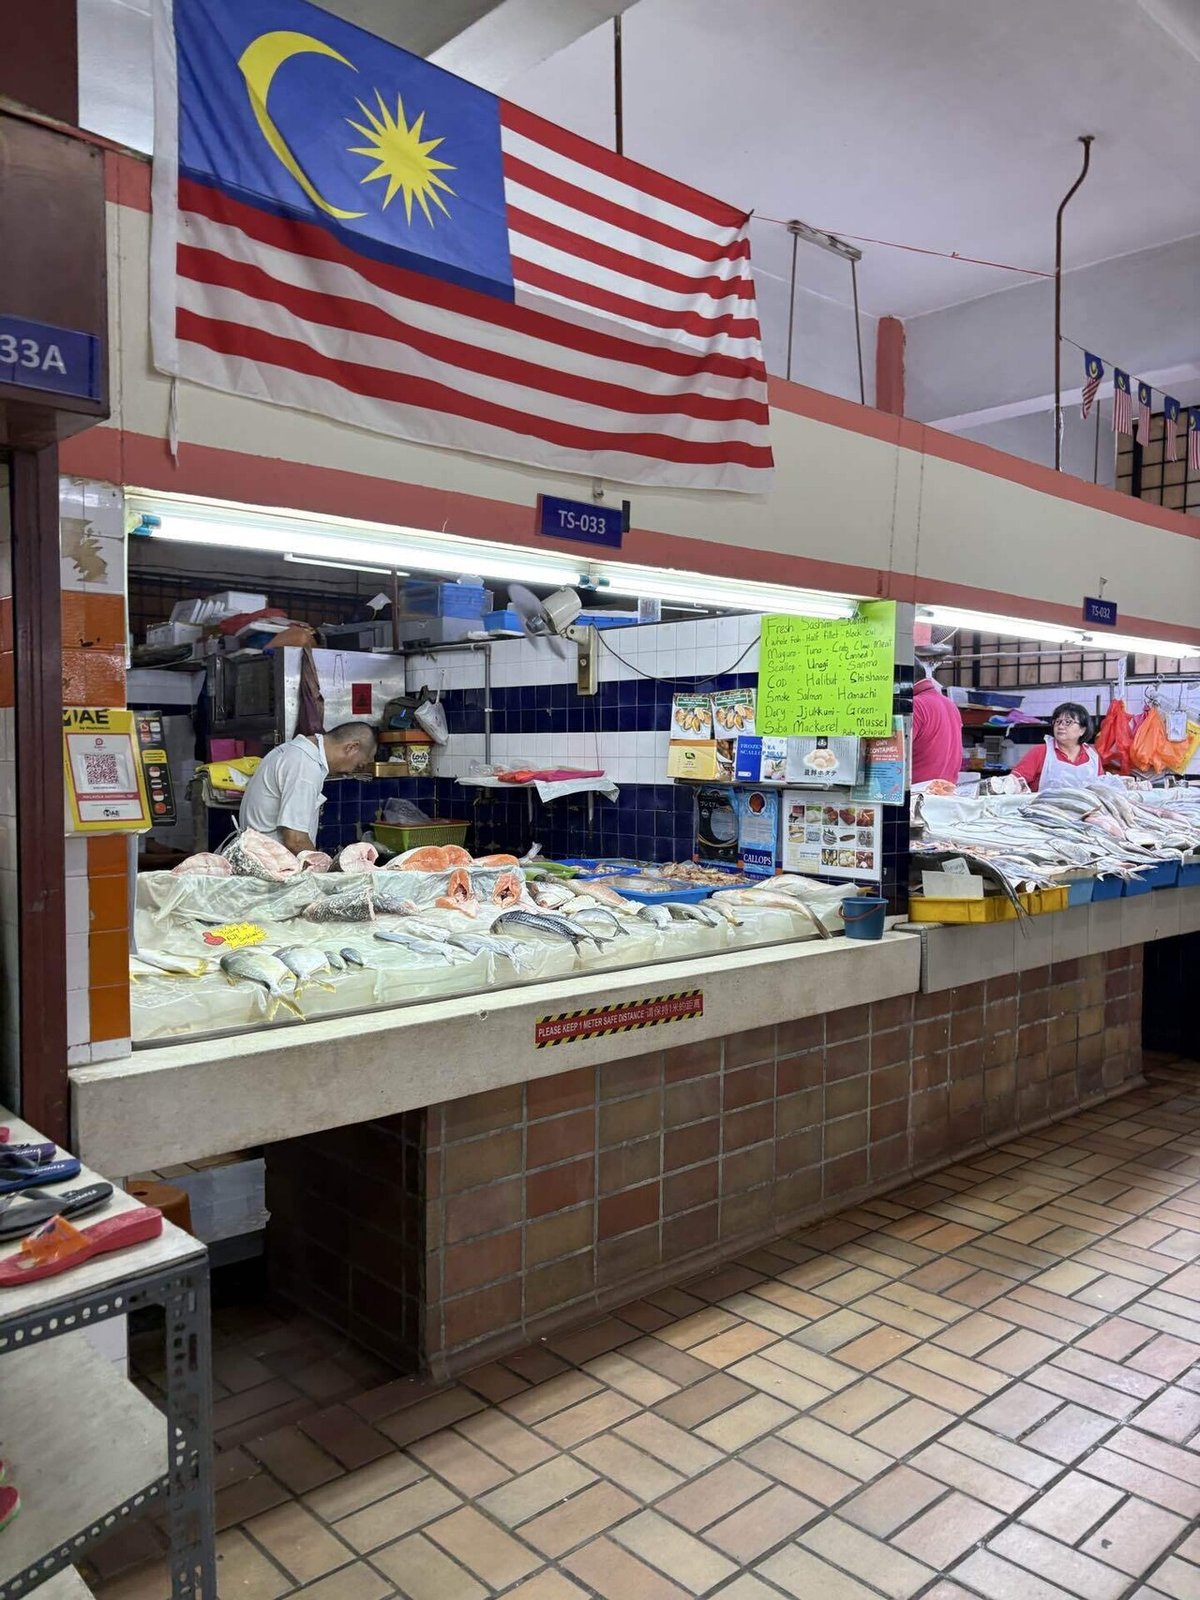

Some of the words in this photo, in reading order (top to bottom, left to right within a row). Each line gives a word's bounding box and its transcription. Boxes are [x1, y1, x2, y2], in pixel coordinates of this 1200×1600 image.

[0, 334, 67, 375] 33A
[558, 510, 606, 534] TS-033
[767, 618, 794, 634] Fresh
[801, 616, 833, 631] Sashimi
[805, 645, 822, 656] Tuna
[806, 673, 838, 687] Halibut
[796, 688, 823, 701] Salmon
[837, 687, 877, 700] Hamachi
[765, 705, 787, 722] Dory
[793, 717, 839, 734] Mackerel
[856, 713, 888, 727] Mussel
[538, 1024, 562, 1037] PLEASE
[562, 1022, 578, 1033] KEEP
[583, 1017, 603, 1029] METER
[603, 1014, 618, 1026] SAFE
[618, 1009, 645, 1023] DISTANCE
